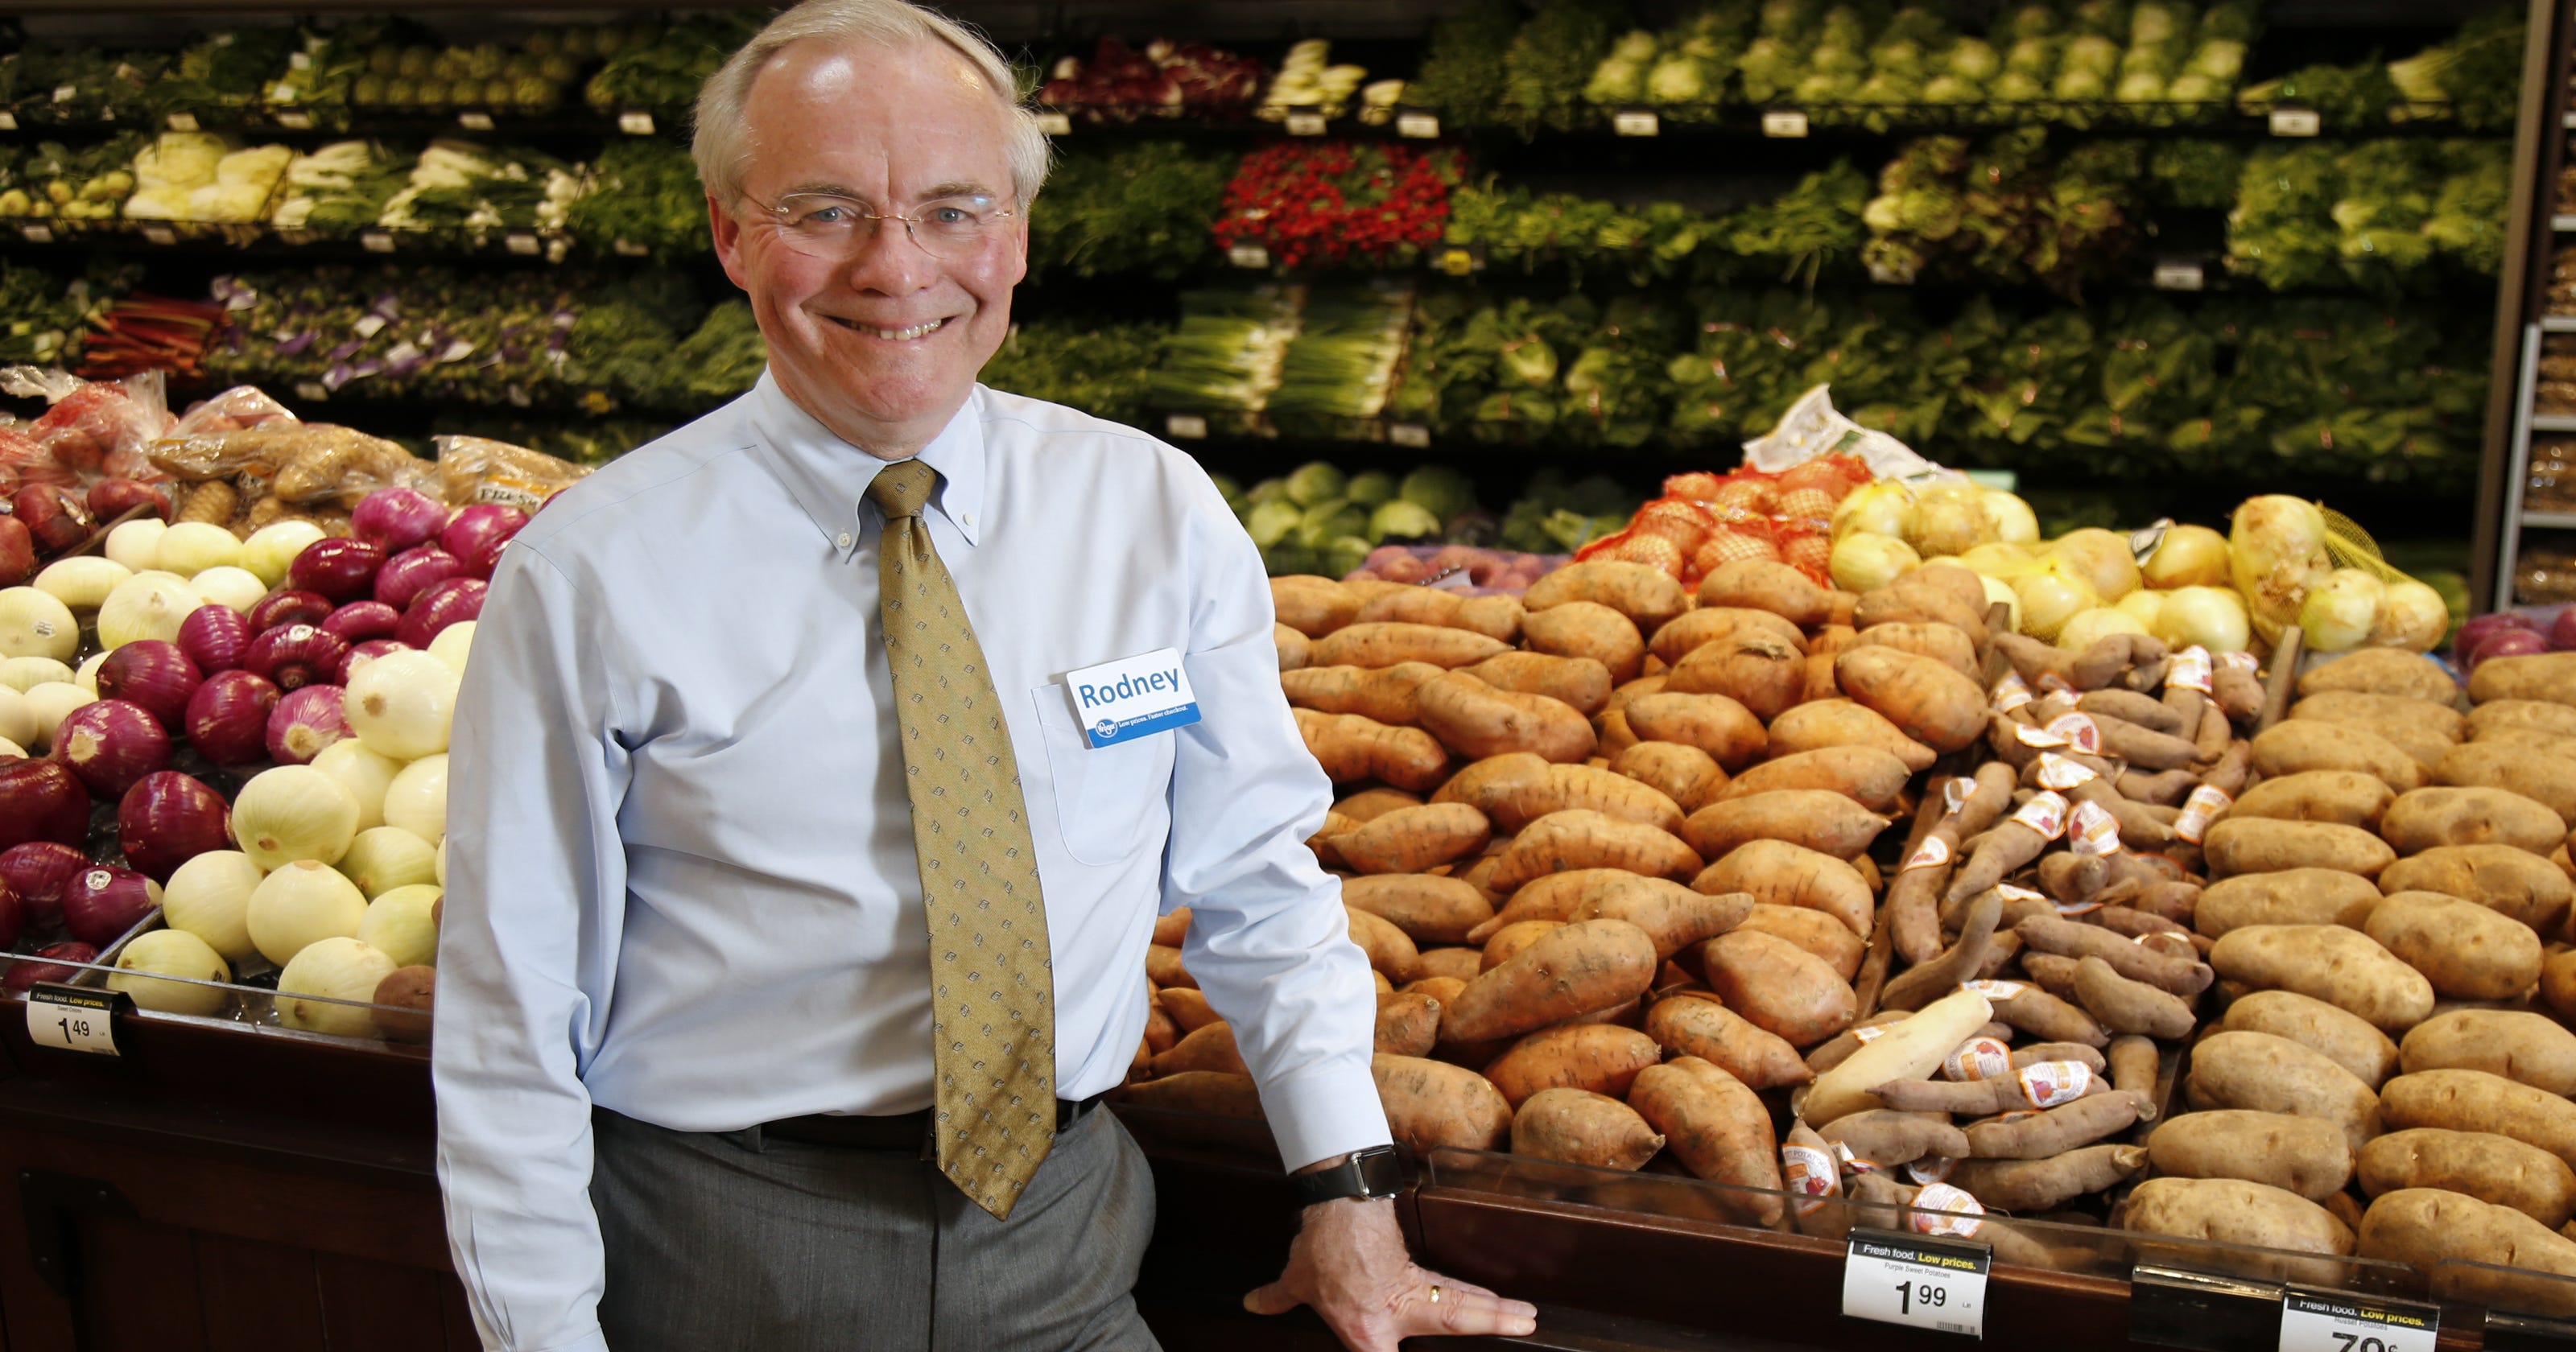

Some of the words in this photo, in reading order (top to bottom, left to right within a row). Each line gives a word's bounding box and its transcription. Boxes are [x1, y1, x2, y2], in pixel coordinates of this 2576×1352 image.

[1079, 668, 1179, 708] Rodney
[1097, 722, 1116, 735] Kroger
[36, 992, 53, 1001] Fresh
[54, 995, 68, 1003] food.
[70, 996, 83, 1004] Low
[84, 999, 104, 1008] prices.
[1864, 1244, 1891, 1256] Fresh
[1893, 1248, 1916, 1260] food.
[1918, 1252, 1940, 1263] Low
[1942, 1257, 1976, 1270] prices.
[1885, 1263, 1904, 1272] Purple
[1905, 1266, 1923, 1274] Sweet
[1925, 1269, 1951, 1279] Potatoes
[2299, 1300, 2330, 1312] Fresh
[2332, 1305, 2357, 1317] food.
[2360, 1309, 2385, 1320] Low
[2386, 1313, 2425, 1327] prices.
